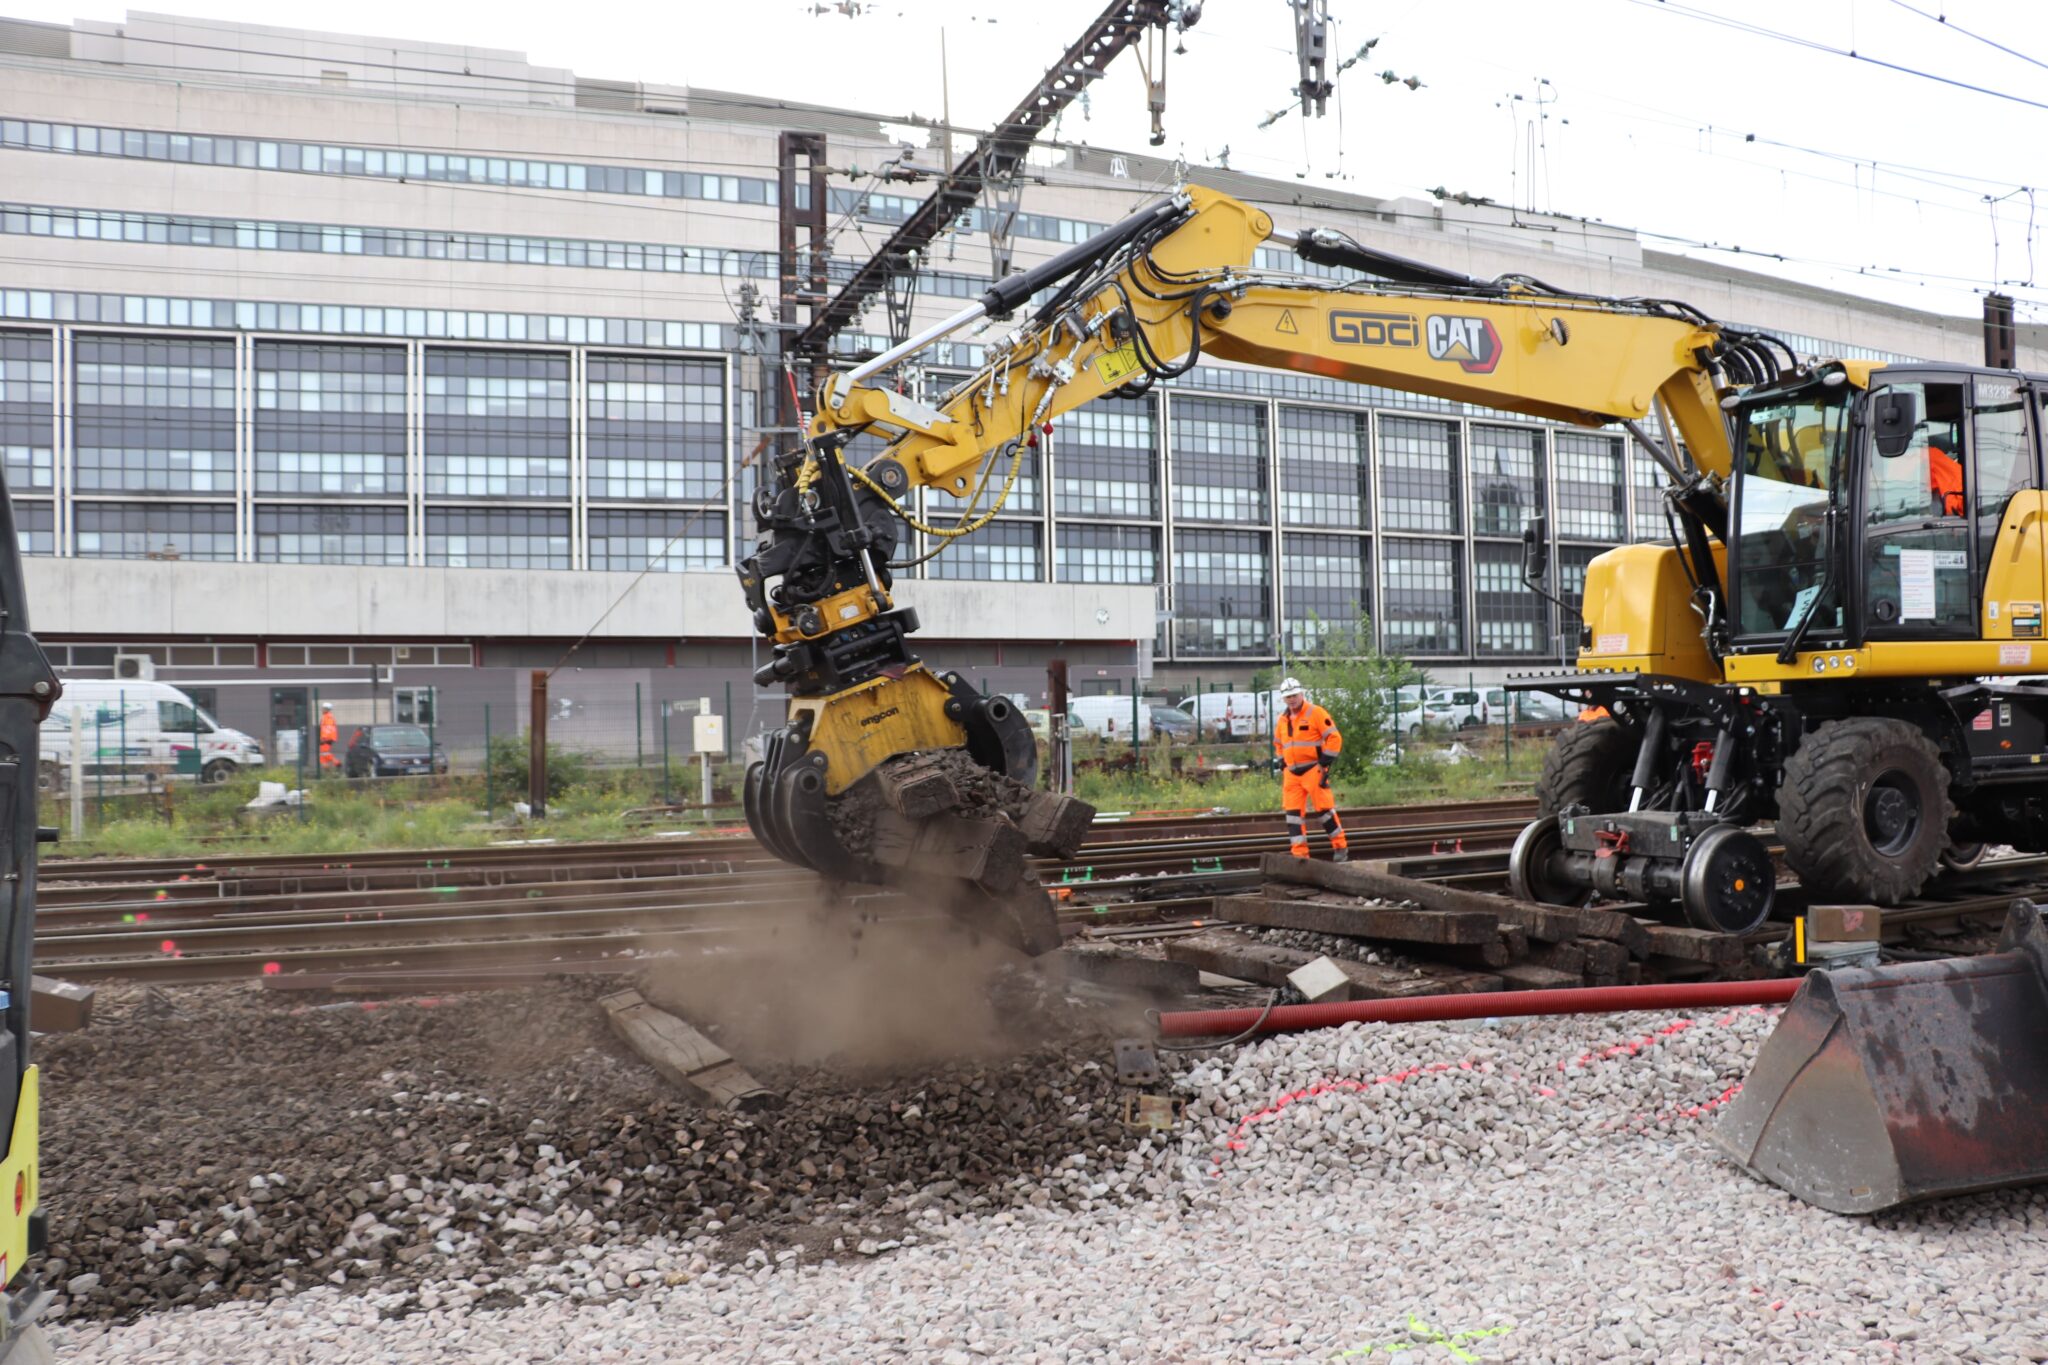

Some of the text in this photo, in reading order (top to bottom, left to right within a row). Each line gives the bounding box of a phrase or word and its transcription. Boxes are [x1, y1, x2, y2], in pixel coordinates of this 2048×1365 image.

[1427, 315, 1483, 361] CAT
[1978, 383, 2012, 399] M323F
[860, 706, 899, 727] engcon
